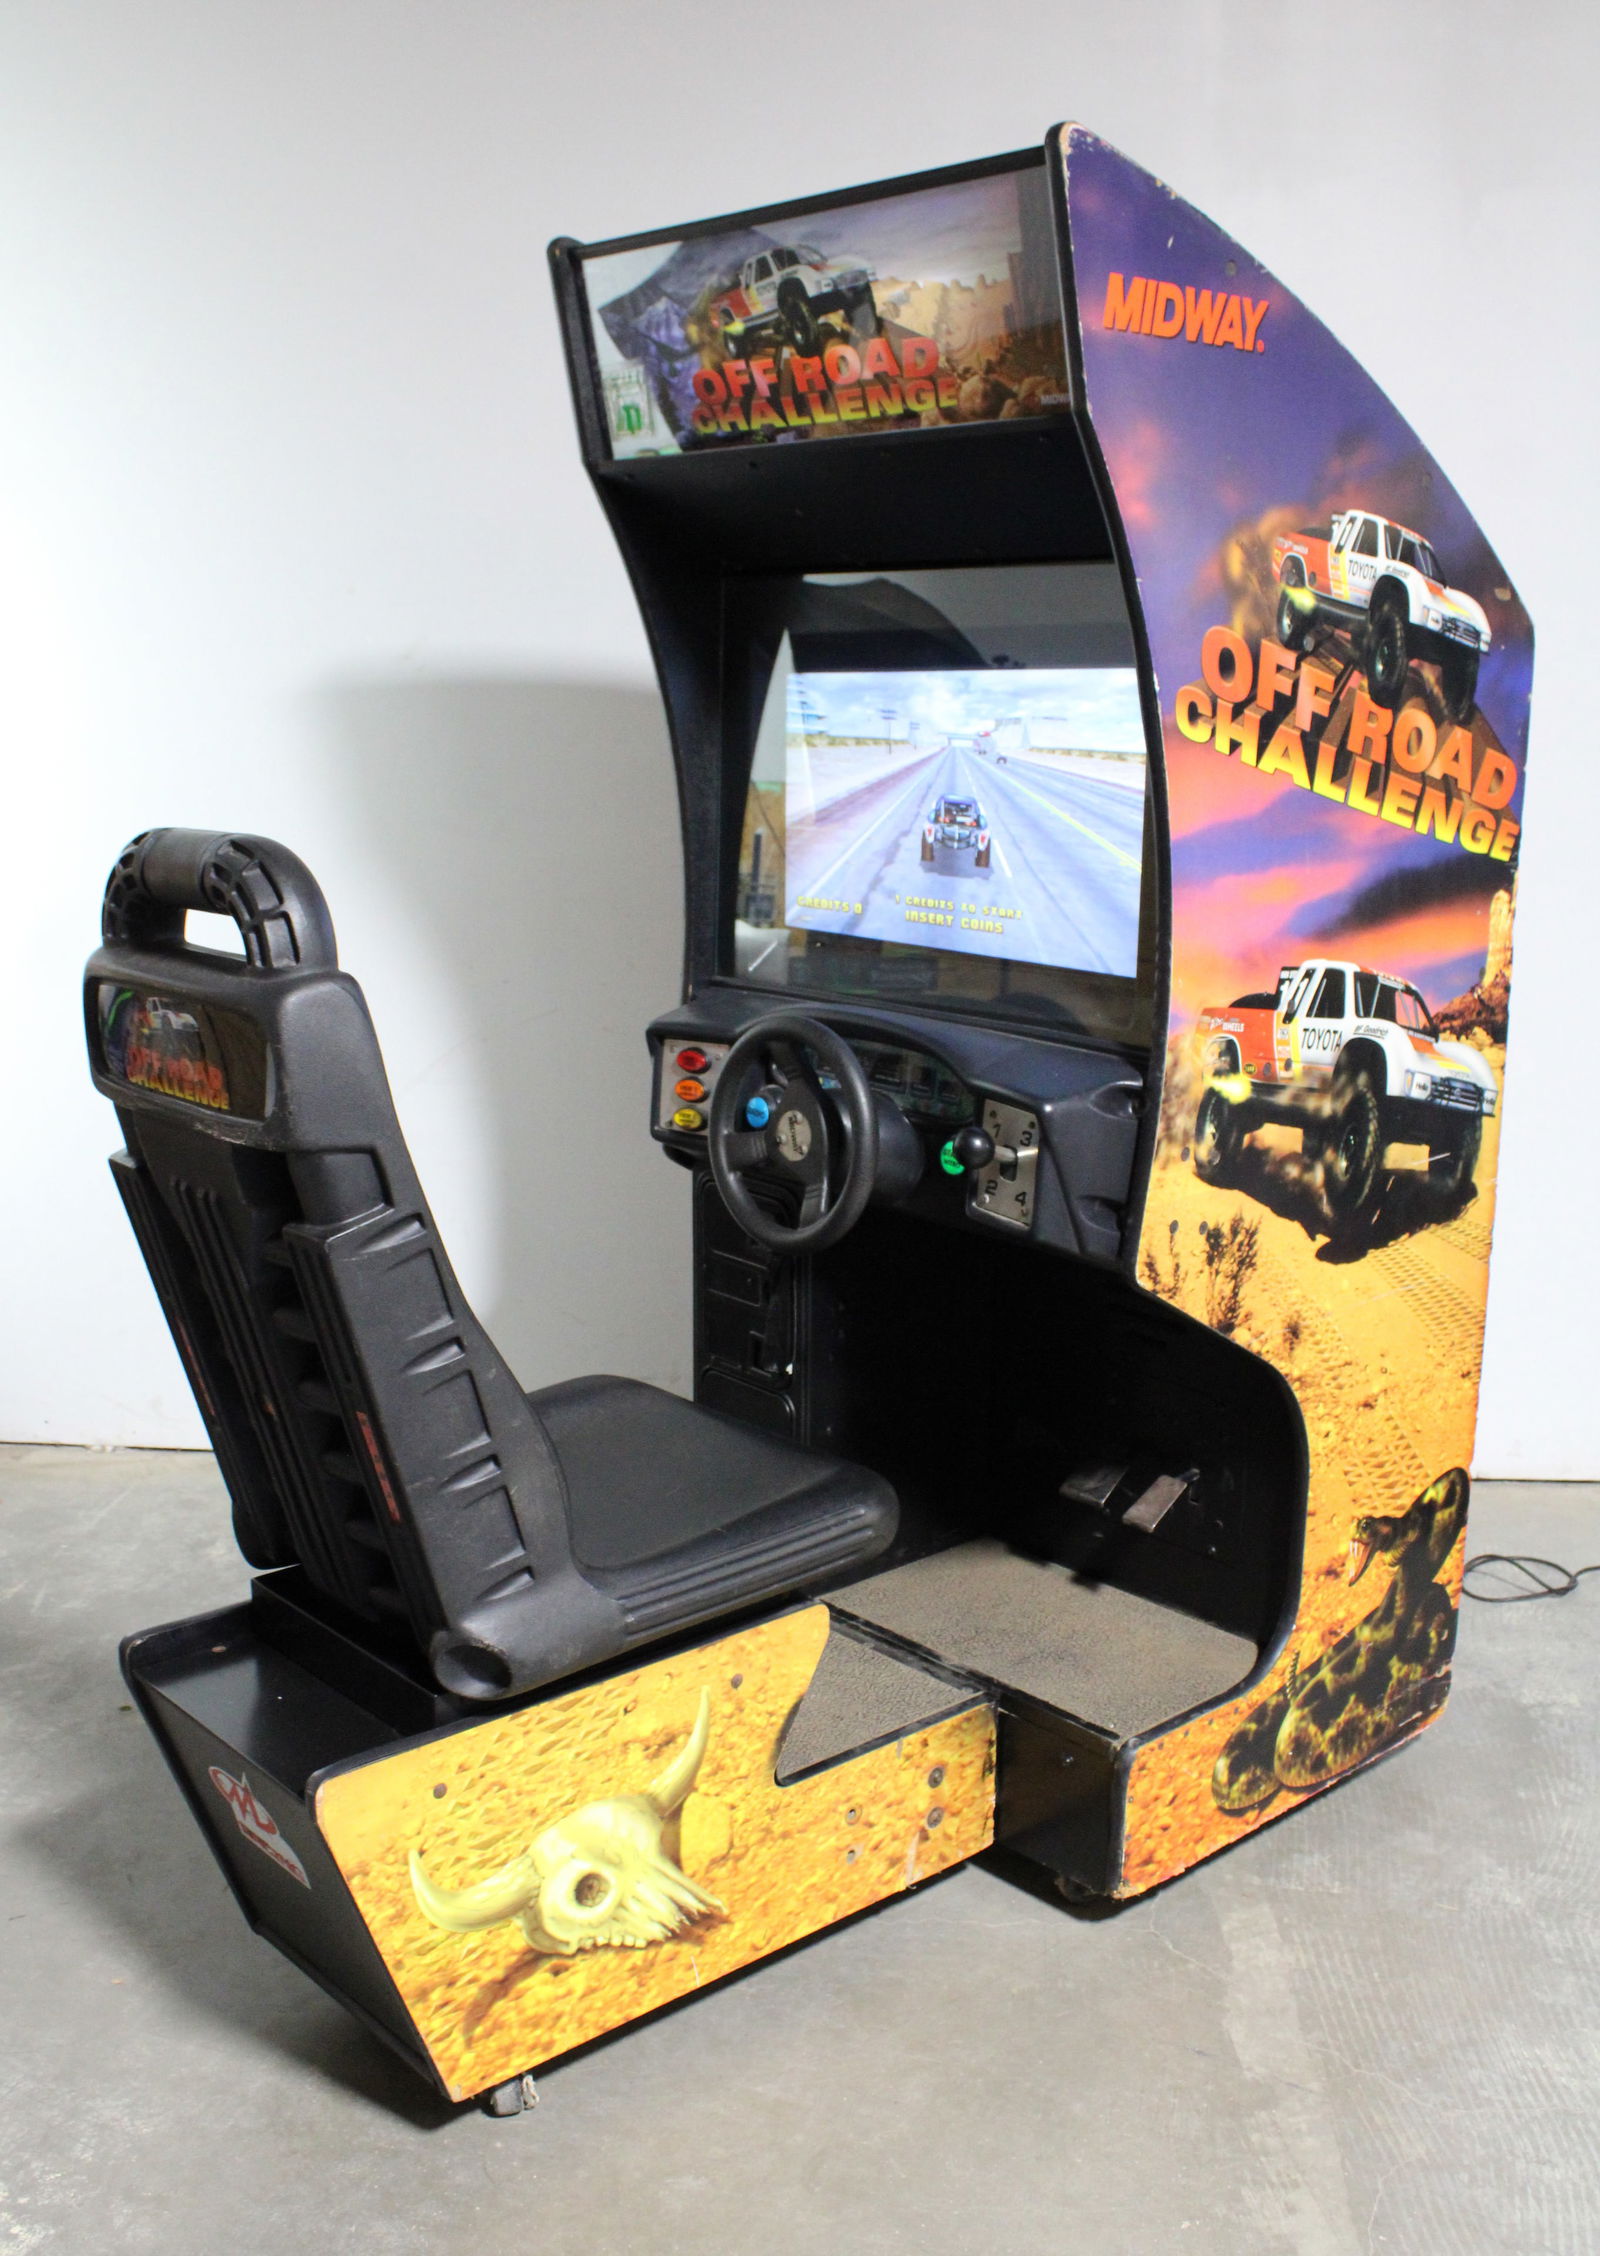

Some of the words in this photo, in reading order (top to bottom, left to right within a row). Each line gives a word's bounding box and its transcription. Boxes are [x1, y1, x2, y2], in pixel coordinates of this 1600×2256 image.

[692, 357, 779, 404] OFF
[790, 337, 941, 394] ROAD
[692, 376, 958, 435] CHALLENGE
[1348, 559, 1378, 582] TOYOTA
[1201, 625, 1337, 732] OFF
[1346, 689, 1518, 811] ROAD
[1175, 685, 1520, 863] CHALLENGE
[797, 896, 849, 913] CREDITS
[905, 896, 954, 911] CREDITS
[961, 903, 977, 914] TO
[982, 907, 1023, 921] START
[905, 910, 954, 927] INSERT
[961, 918, 1004, 934] COINS
[1302, 1028, 1344, 1053] TOYOTA
[992, 1124, 1002, 1138] 1
[1020, 1131, 1032, 1147] 3
[984, 1180, 998, 1196] 2
[1015, 1191, 1027, 1206] 4
